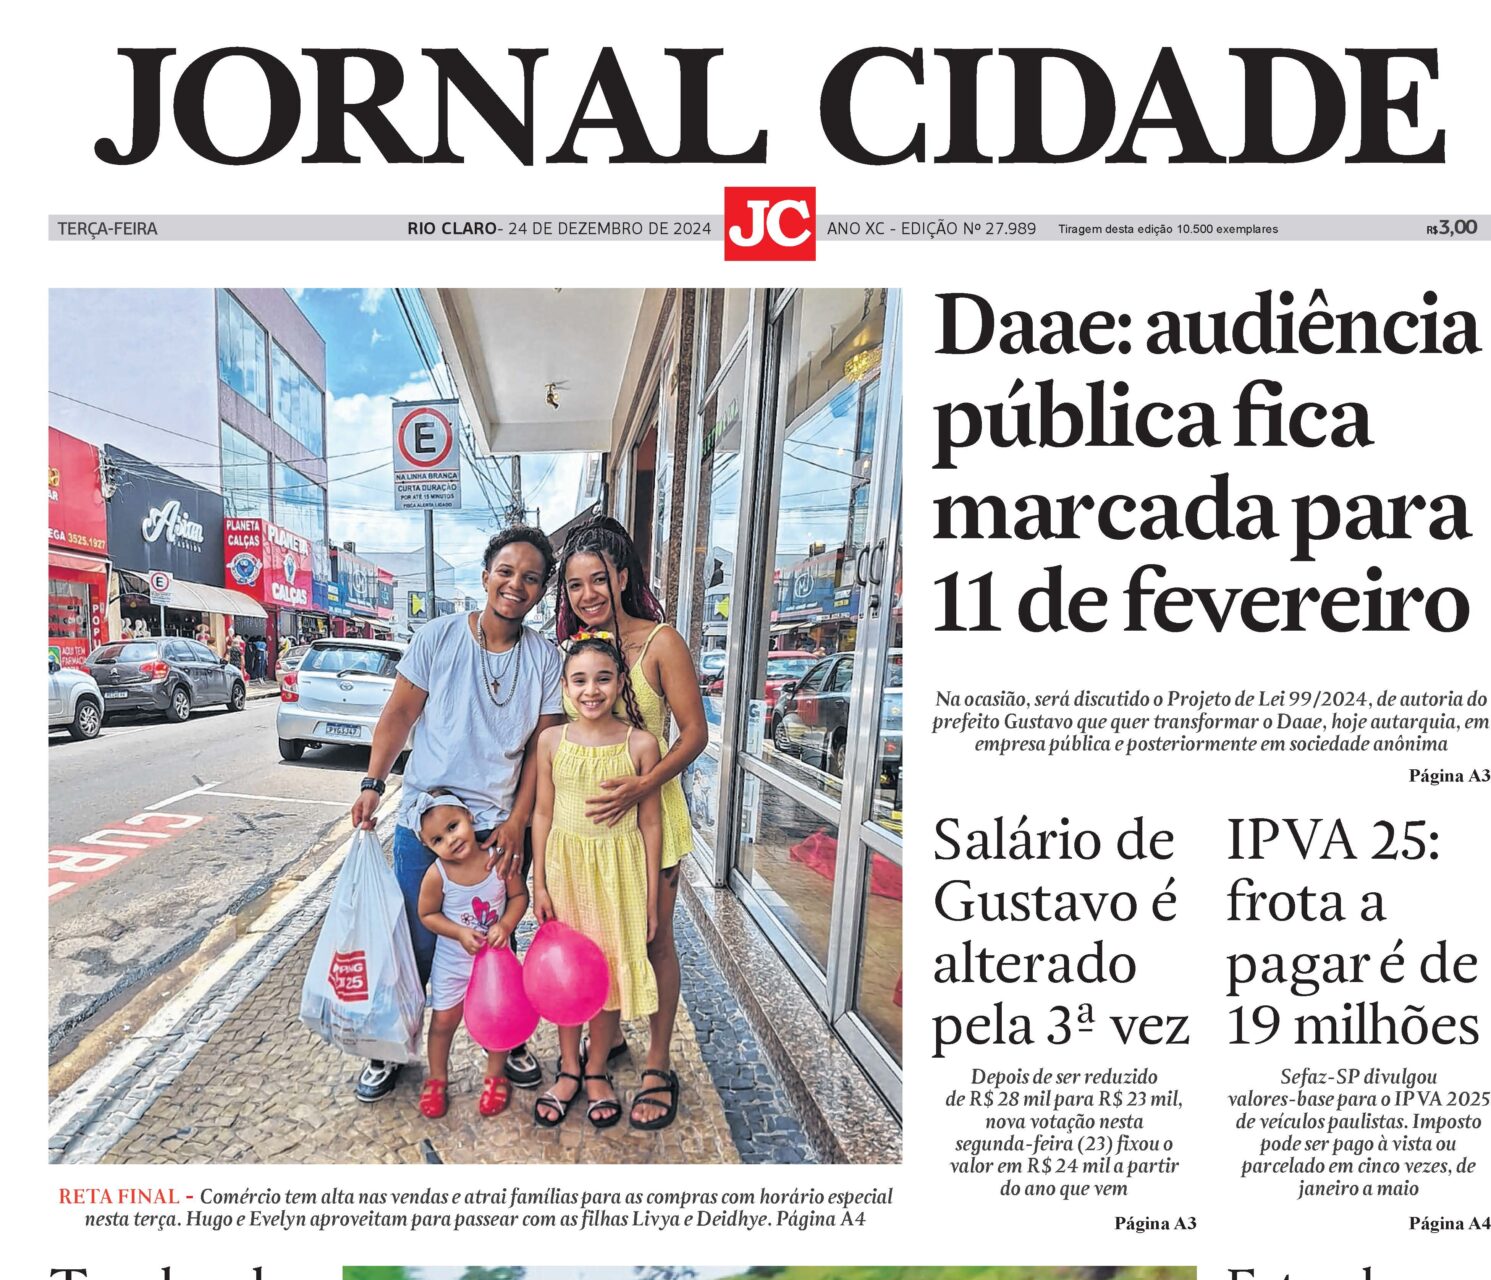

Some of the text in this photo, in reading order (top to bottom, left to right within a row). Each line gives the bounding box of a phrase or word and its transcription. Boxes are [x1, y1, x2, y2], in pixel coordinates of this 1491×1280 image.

[94, 46, 1445, 166] JORNAL CIDADE
[58, 222, 157, 240] TERÇA-FEIRA
[408, 222, 711, 234] RIO CLARO- 24 DE DEZEMBRO DE 2024
[728, 199, 812, 248] JC
[827, 222, 860, 234] ANO
[866, 222, 884, 234] XC
[902, 219, 957, 239] EDIÇÃO
[986, 222, 1036, 234] 27.989
[1059, 224, 1278, 236] Tiragem desta edição 10.500 exemplares
[1427, 220, 1477, 237] R$3,00
[935, 289, 1482, 354] Daae: audiência
[415, 422, 436, 453] E
[932, 378, 1375, 469] pública fica
[226, 520, 260, 531] PLANETA
[933, 472, 1473, 561] marcada para
[228, 535, 260, 549] CALÇAS
[267, 524, 309, 556] PLANETA
[272, 582, 307, 606] CALÇAS
[934, 564, 1469, 632] 11 de fevereiro
[935, 815, 1173, 860] Salário de
[1228, 818, 1438, 860] IPVA 25:
[935, 877, 1176, 921] Gustavo é
[1227, 878, 1387, 921] frota a
[934, 940, 1136, 983] alterado
[1226, 938, 1477, 996] pagar é de
[932, 1001, 1035, 1058] pela
[1109, 1016, 1189, 1044] vez
[1229, 1001, 1479, 1044] 19 milhões
